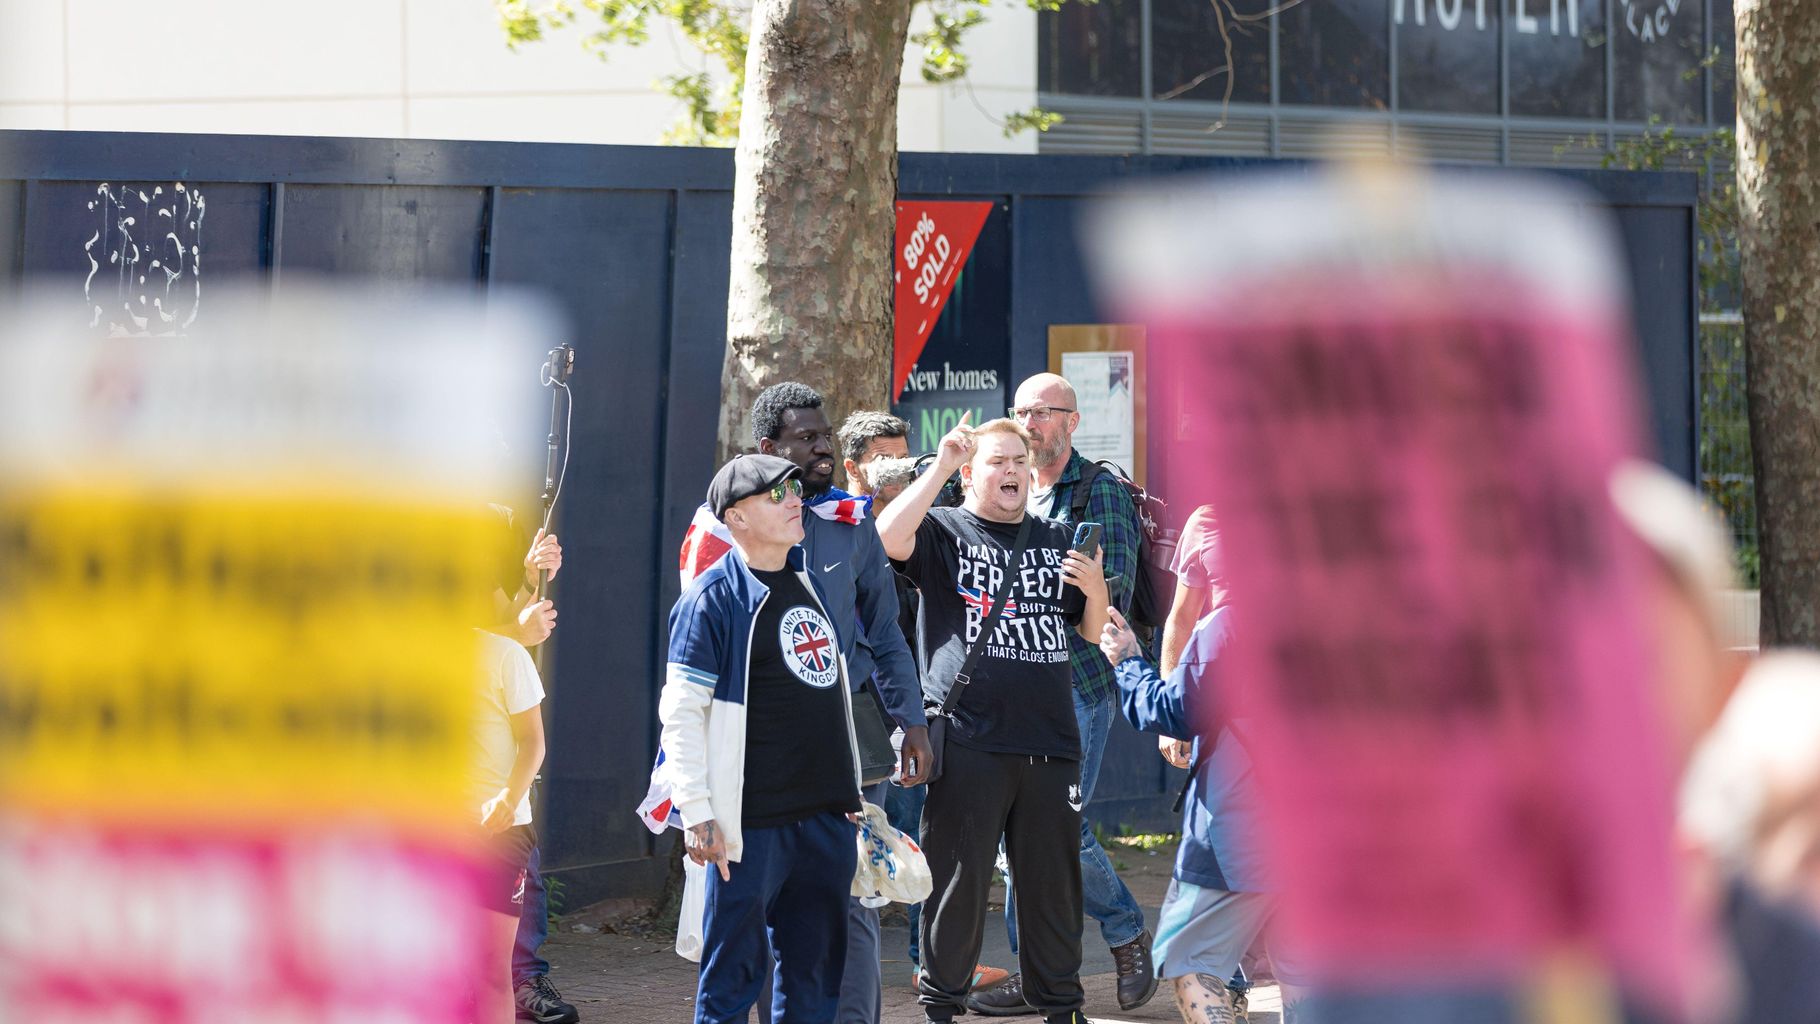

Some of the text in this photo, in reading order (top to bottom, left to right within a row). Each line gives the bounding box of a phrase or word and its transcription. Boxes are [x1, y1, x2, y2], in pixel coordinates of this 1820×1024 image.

[1620, 0, 1681, 43] LAC
[903, 211, 936, 271] 80%
[914, 233, 951, 305] SOLD
[903, 361, 998, 392] New homes
[967, 544, 999, 565] MAY
[1041, 547, 1064, 567] BE
[782, 609, 823, 636] UNITE THE
[986, 644, 1017, 660] THATS
[1019, 649, 1047, 664] CLOSE
